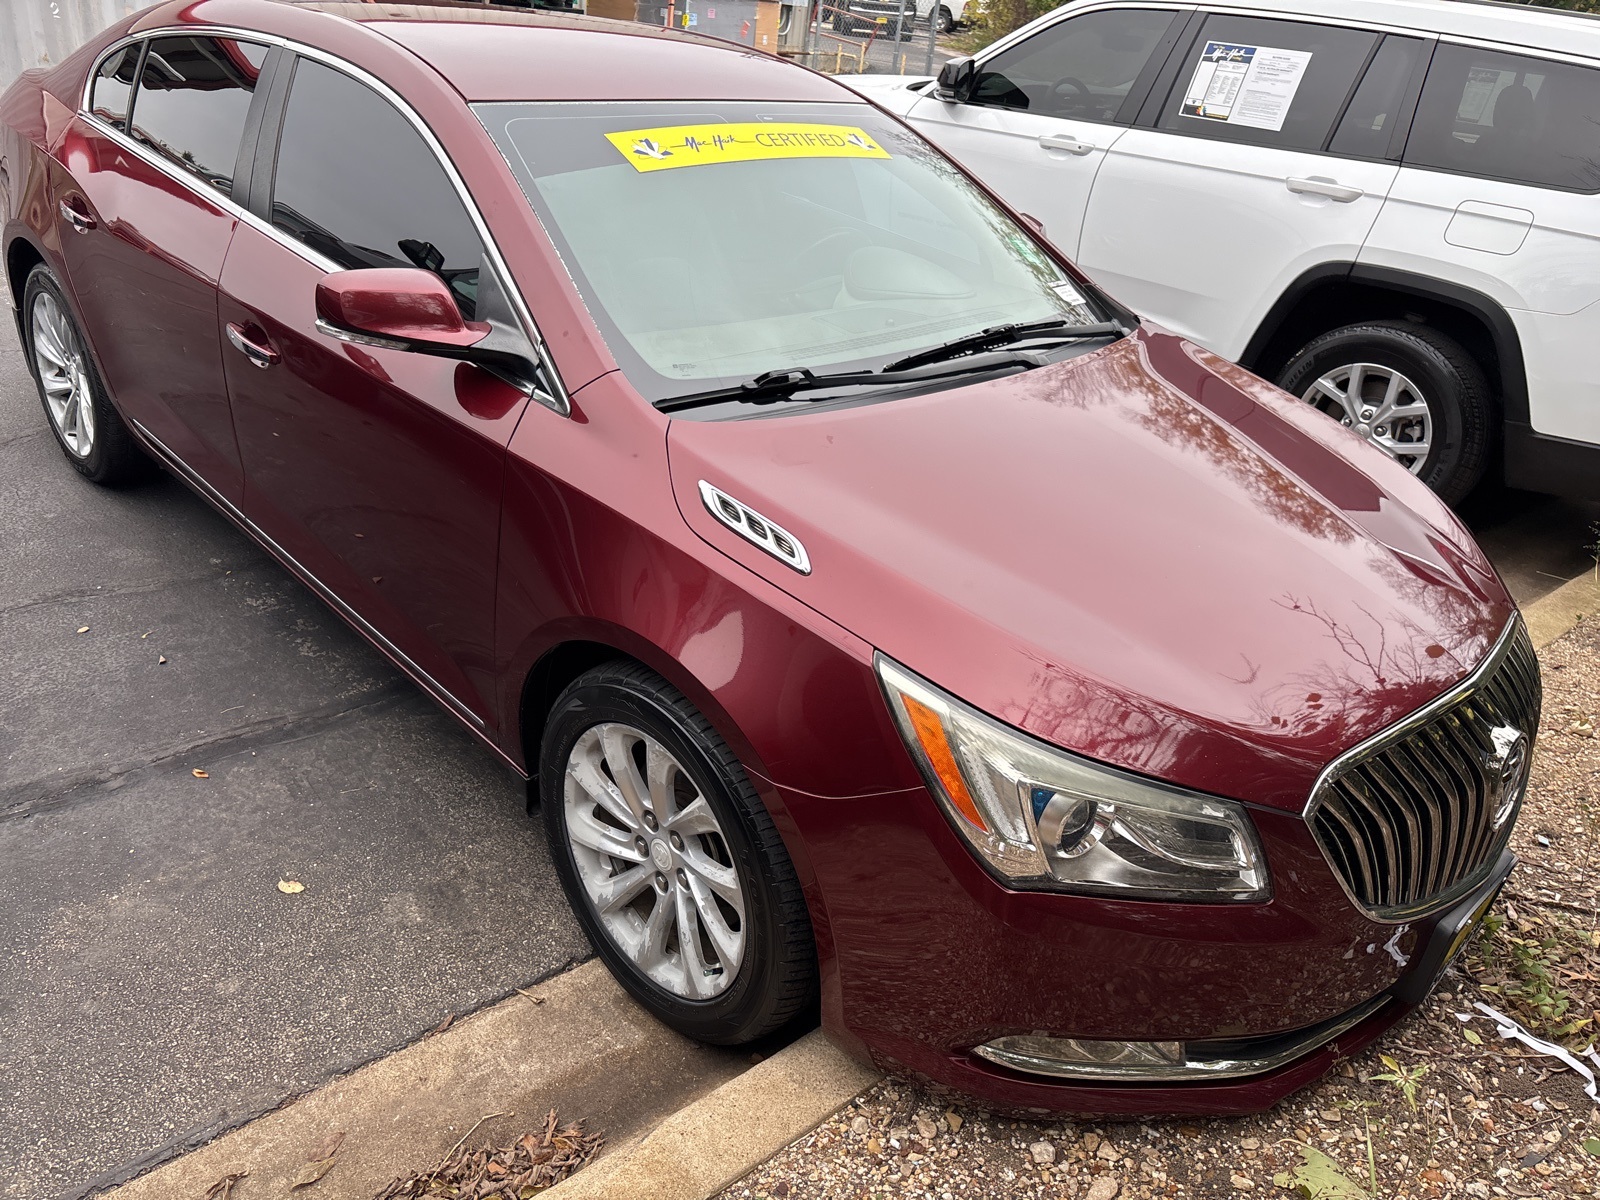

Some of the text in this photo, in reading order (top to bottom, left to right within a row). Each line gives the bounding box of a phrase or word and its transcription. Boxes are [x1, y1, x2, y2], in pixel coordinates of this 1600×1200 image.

[685, 132, 846, 153] Mac Haik CERTIFIED
